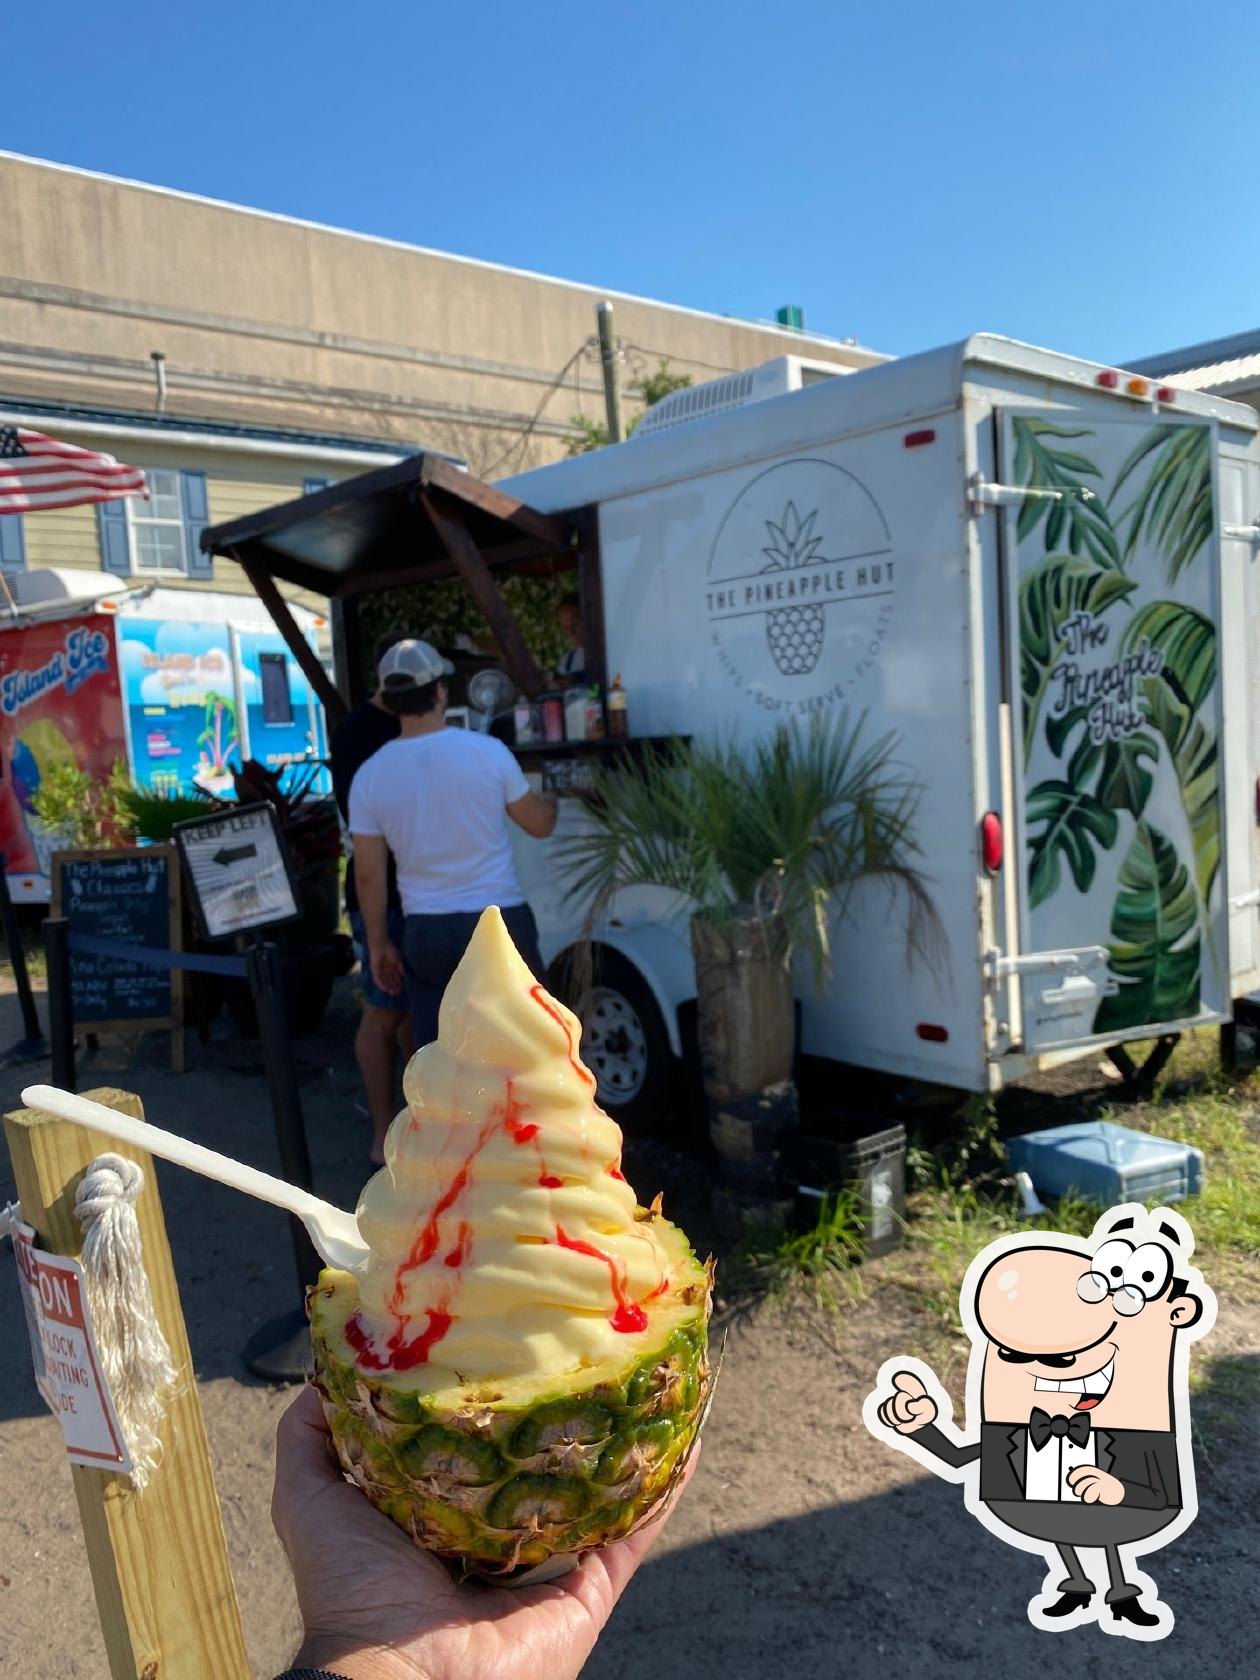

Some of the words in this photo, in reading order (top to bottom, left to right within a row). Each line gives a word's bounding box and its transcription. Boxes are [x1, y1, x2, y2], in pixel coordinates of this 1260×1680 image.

[706, 589, 737, 611] THE
[744, 570, 845, 605] PINEAPPLE
[856, 562, 896, 586] HUT
[1059, 613, 1110, 655] The
[2, 652, 64, 713] Island
[67, 628, 108, 669] Ice
[1050, 638, 1164, 713] Pineapple
[754, 689, 793, 712] SOFT
[1091, 700, 1146, 741] Hut
[184, 821, 225, 844] KEEP
[229, 812, 266, 833] LEFT
